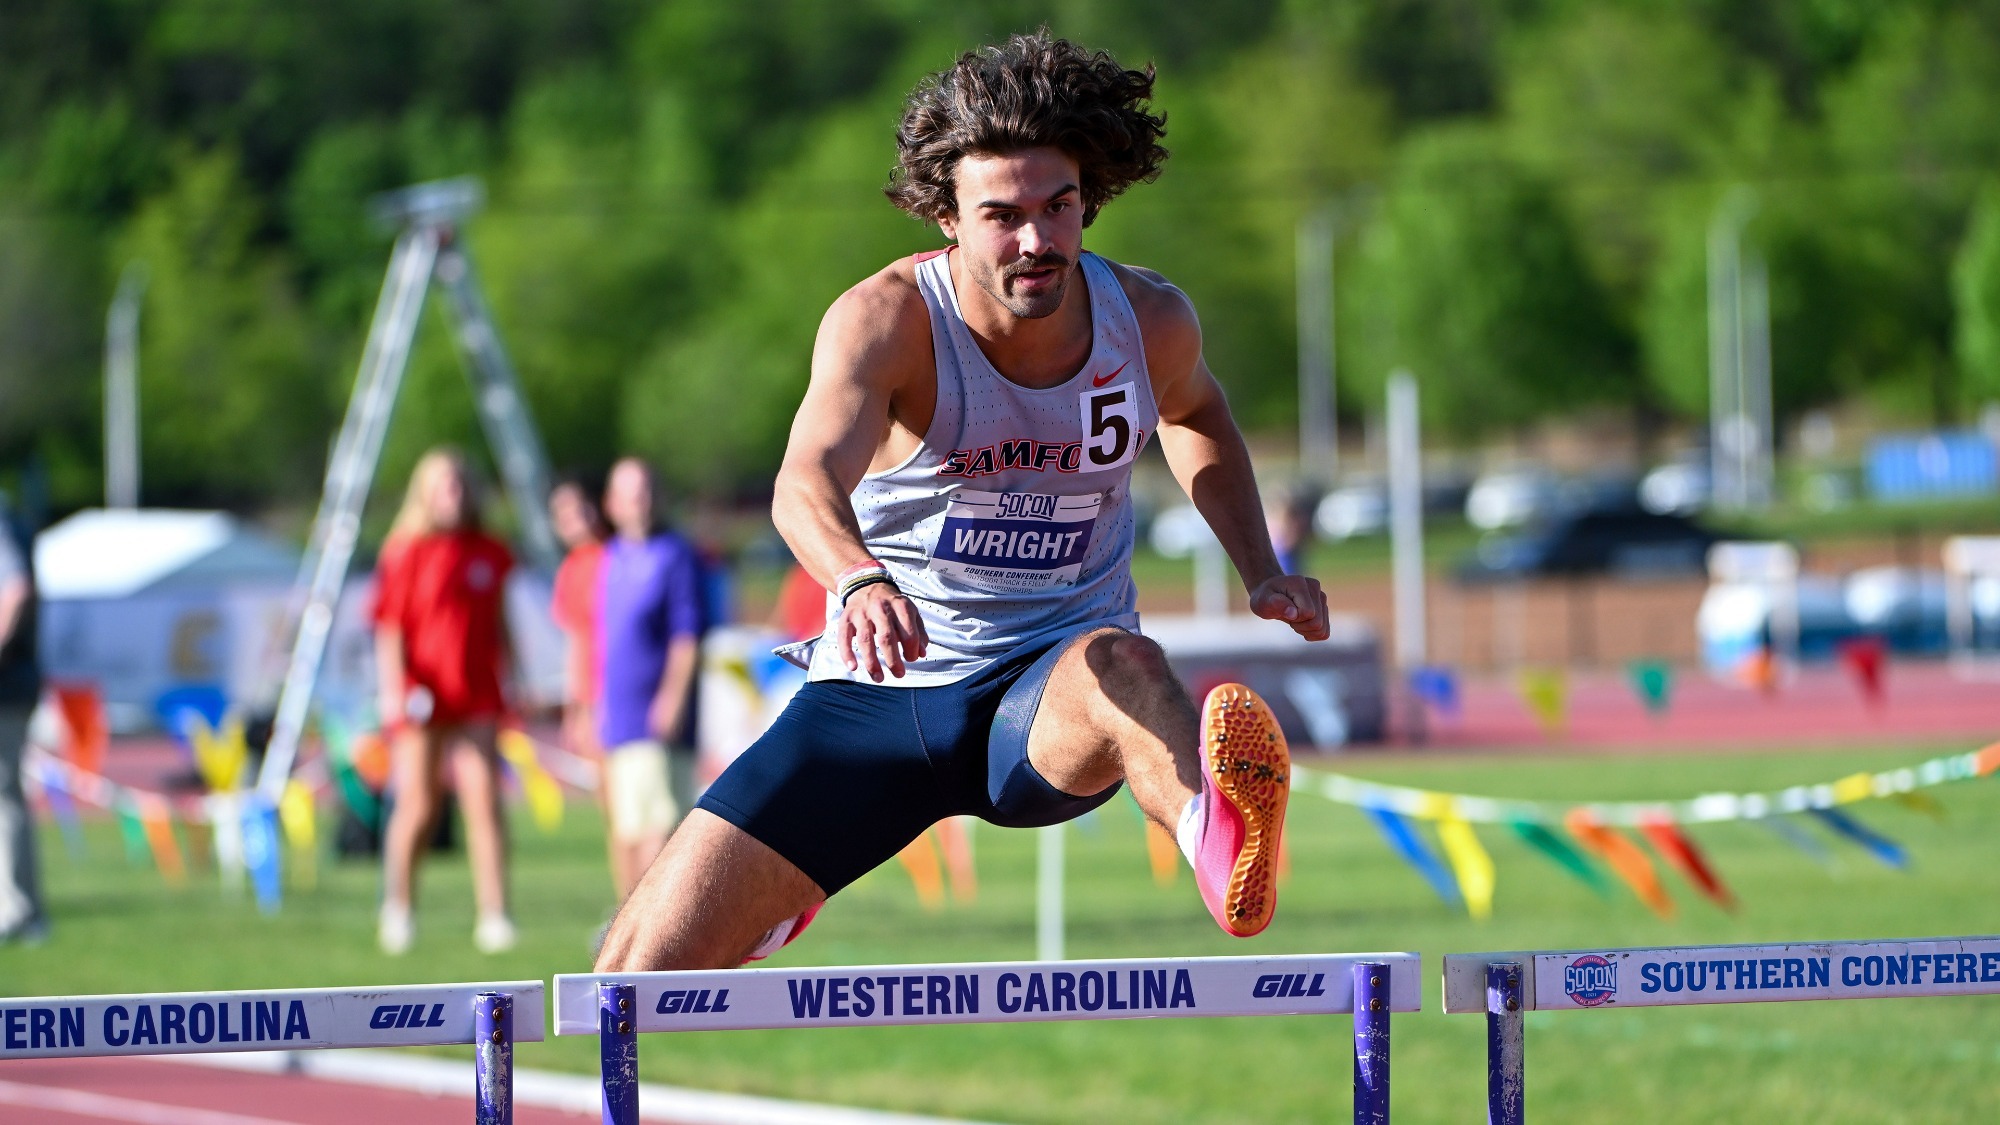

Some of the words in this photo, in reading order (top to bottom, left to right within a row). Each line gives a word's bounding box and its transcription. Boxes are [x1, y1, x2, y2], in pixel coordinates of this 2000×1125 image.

[1088, 389, 1130, 466] 5
[937, 431, 1144, 478] SAMFO
[953, 528, 1083, 560] WRIGHT
[964, 567, 1005, 578] SOUTHERN
[1005, 571, 1053, 580] CONFERENCE
[967, 574, 999, 583] OUTDOOR
[999, 579, 1021, 587] TRACK
[1028, 580, 1047, 588] FIELD
[977, 582, 1033, 595] CHAMPIONSHIPS
[1252, 973, 1326, 999] GILL
[1565, 962, 1617, 995] SOCON
[1640, 957, 1831, 994] SOUTHERN
[656, 989, 730, 1015] GILL
[787, 973, 980, 1019] WESTERN
[996, 968, 1196, 1014] CAROLINA
[0, 1007, 85, 1050] ERN
[103, 1000, 311, 1047] CAROLINA
[369, 1003, 445, 1030] GILL
